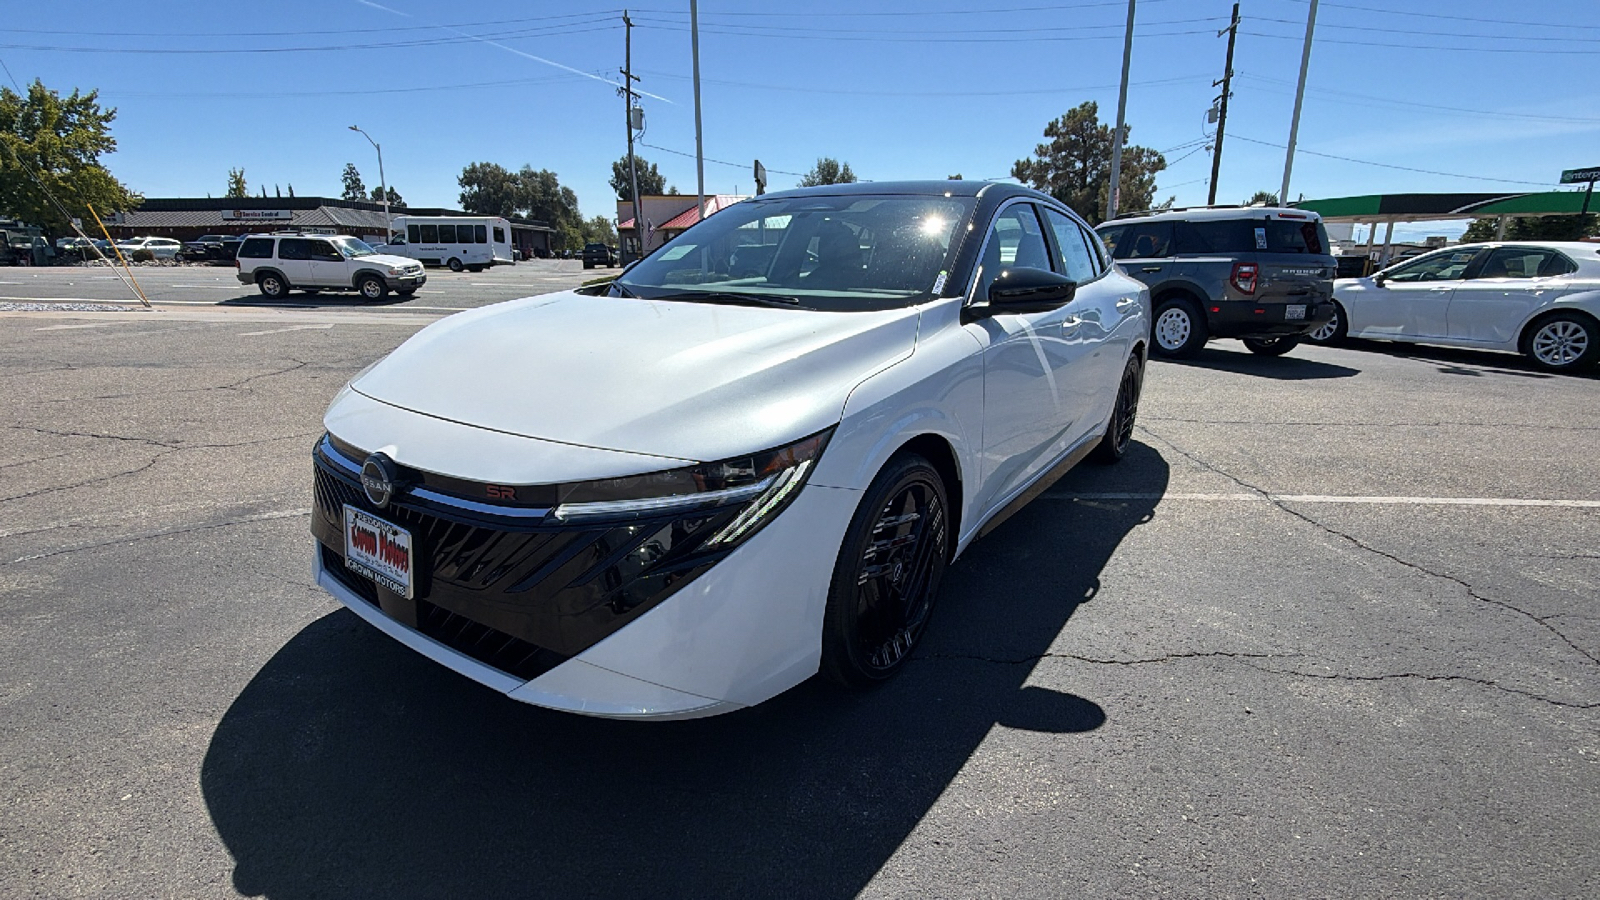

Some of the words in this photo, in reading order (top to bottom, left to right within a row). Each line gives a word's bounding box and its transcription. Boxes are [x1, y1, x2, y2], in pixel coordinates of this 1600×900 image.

[486, 485, 516, 500] SR
[358, 513, 393, 534] REDDING
[348, 560, 374, 579] CROWN
[375, 572, 406, 596] MOTORS
